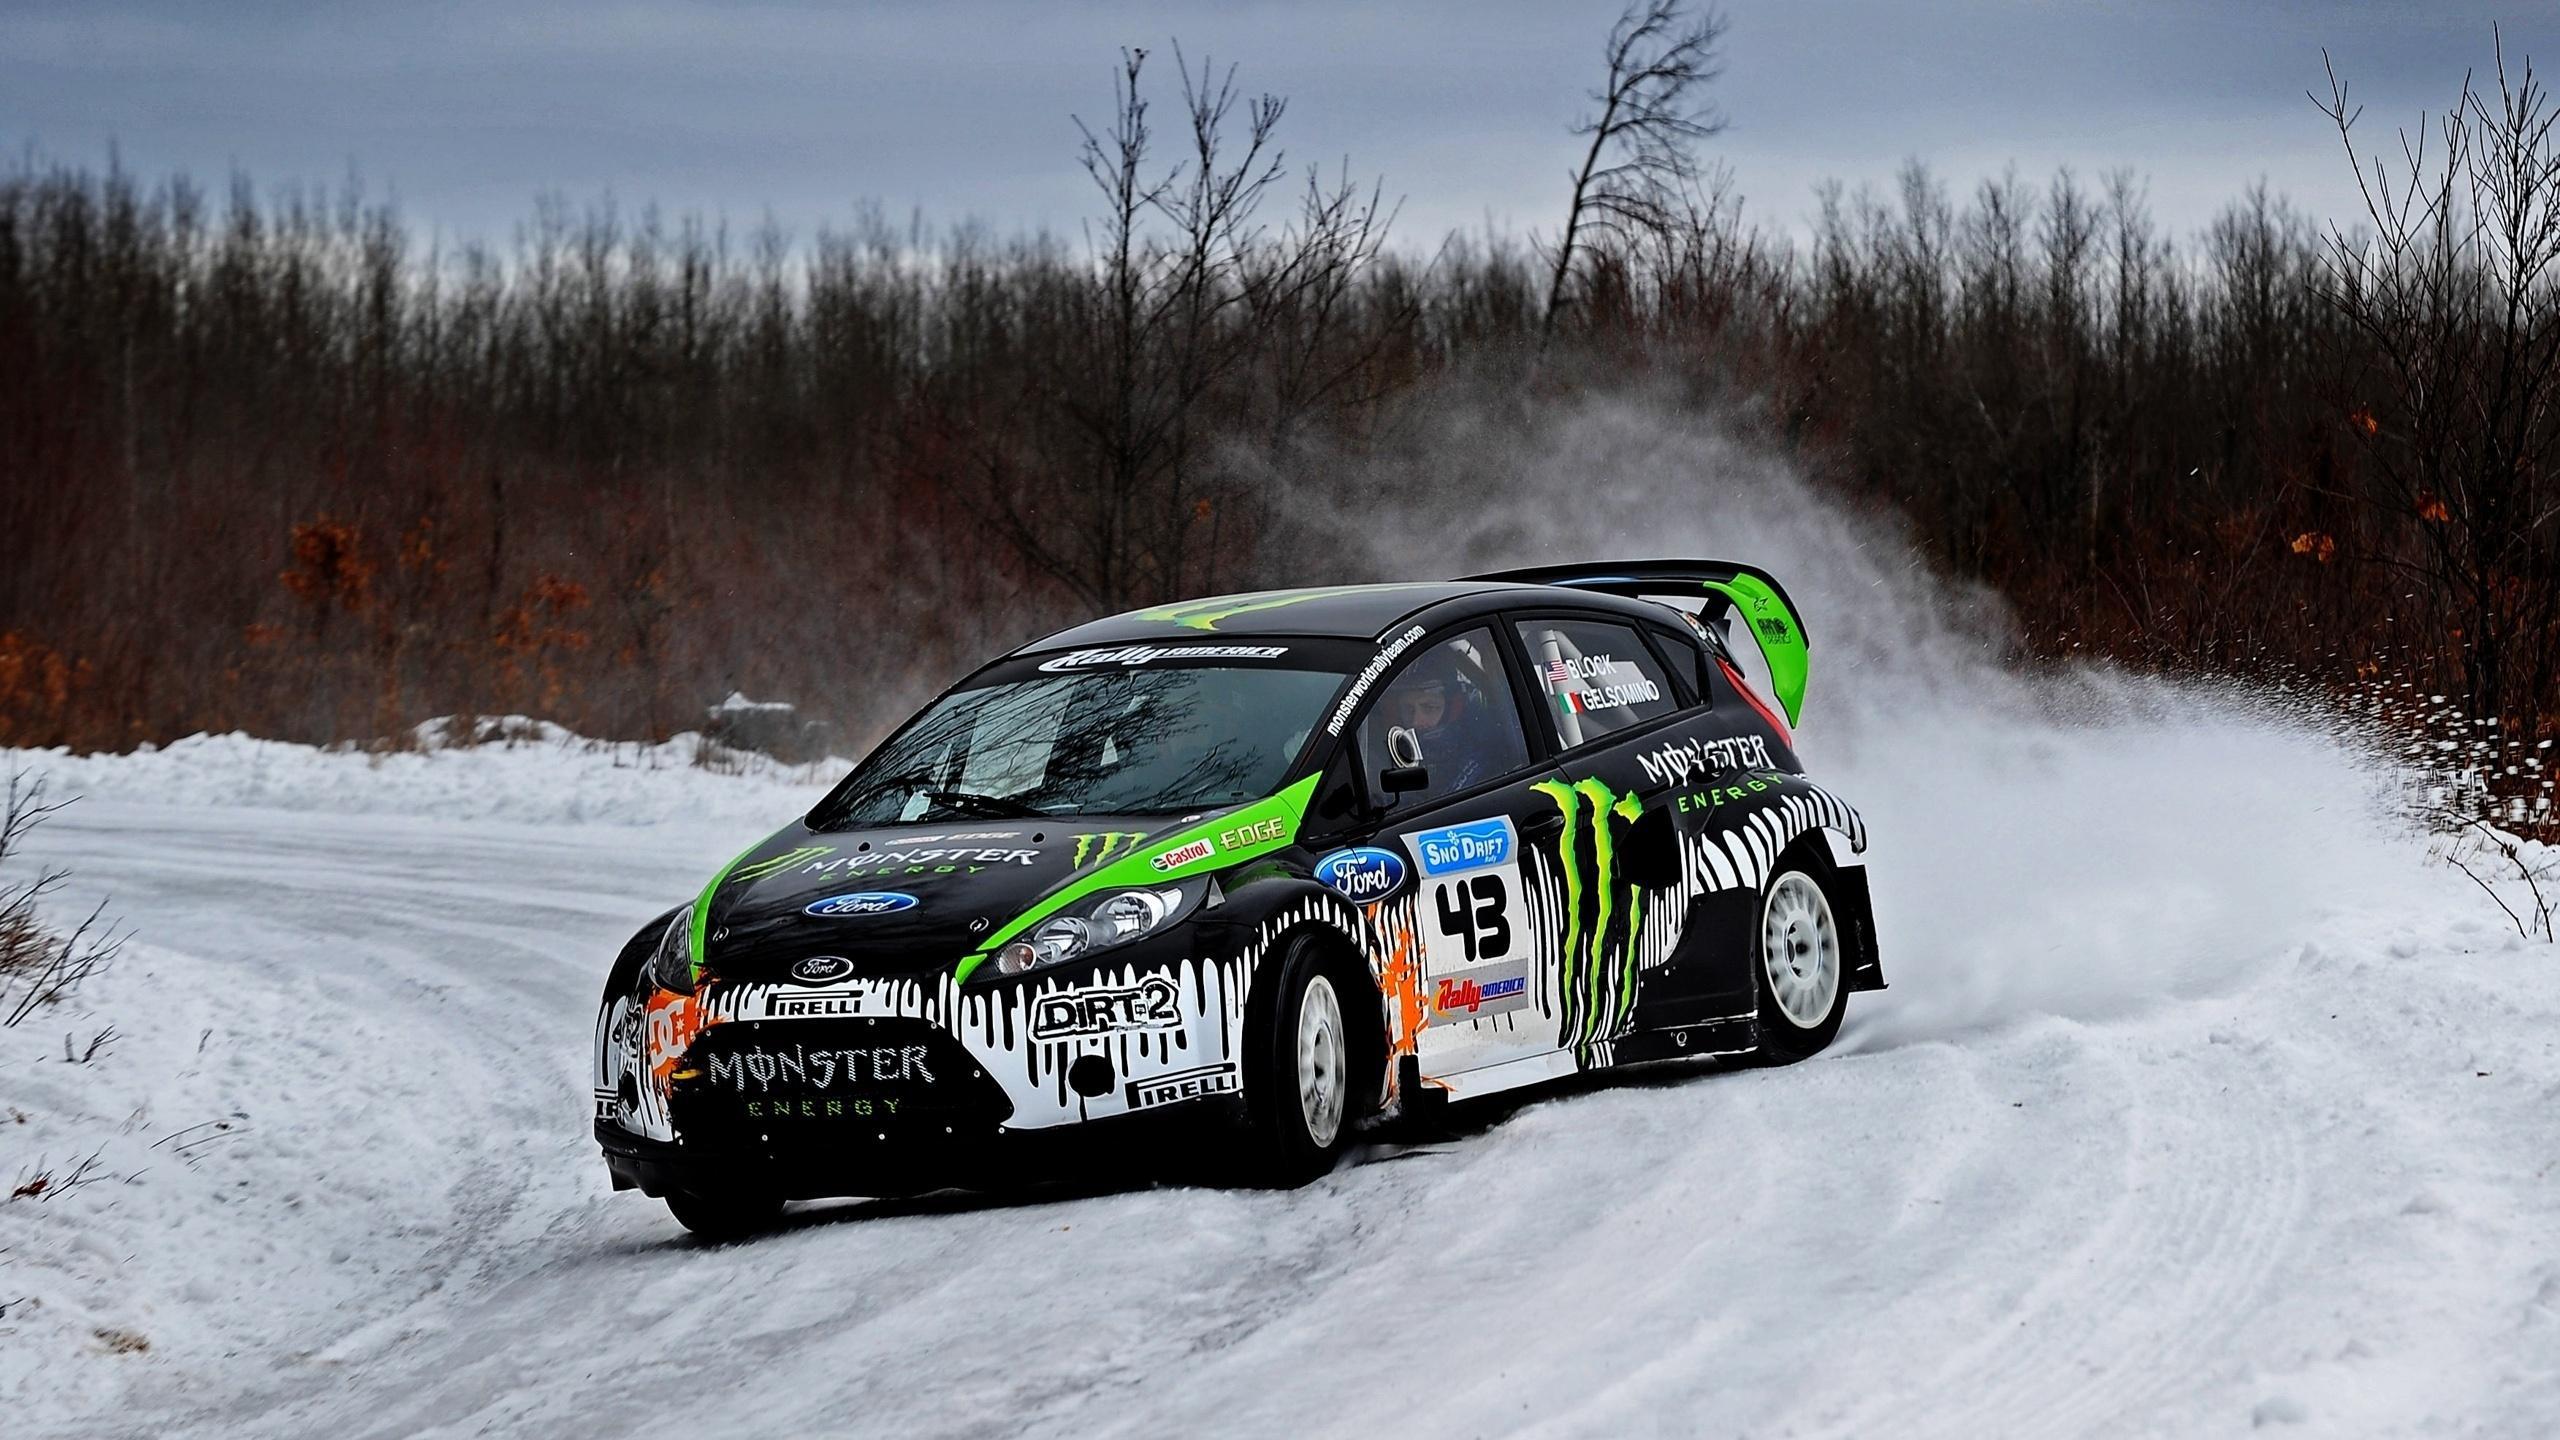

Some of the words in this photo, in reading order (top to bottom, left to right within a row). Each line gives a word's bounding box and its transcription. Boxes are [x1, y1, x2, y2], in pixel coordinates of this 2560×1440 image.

[1326, 624, 1426, 737] monsterworldrallyteam.com
[1565, 654, 1616, 680] BLOCK
[1581, 679, 1660, 711] GELSOMINO
[1677, 774, 1783, 814] ENERGY
[1166, 841, 1210, 868] Castrol
[1219, 816, 1287, 851] EDGE
[1426, 842, 1460, 866] SNO
[819, 865, 987, 881] ENERGY
[1335, 857, 1391, 896] Ford
[822, 895, 896, 914] Ford
[1435, 873, 1512, 963] 43
[801, 957, 842, 978] Ford
[765, 990, 864, 1016] PIRELLI
[1437, 978, 1481, 1013] Rally
[1481, 976, 1526, 998] AMERICA
[1124, 1061, 1237, 1110] PIRELLI
[748, 1098, 900, 1117] ENERGY
